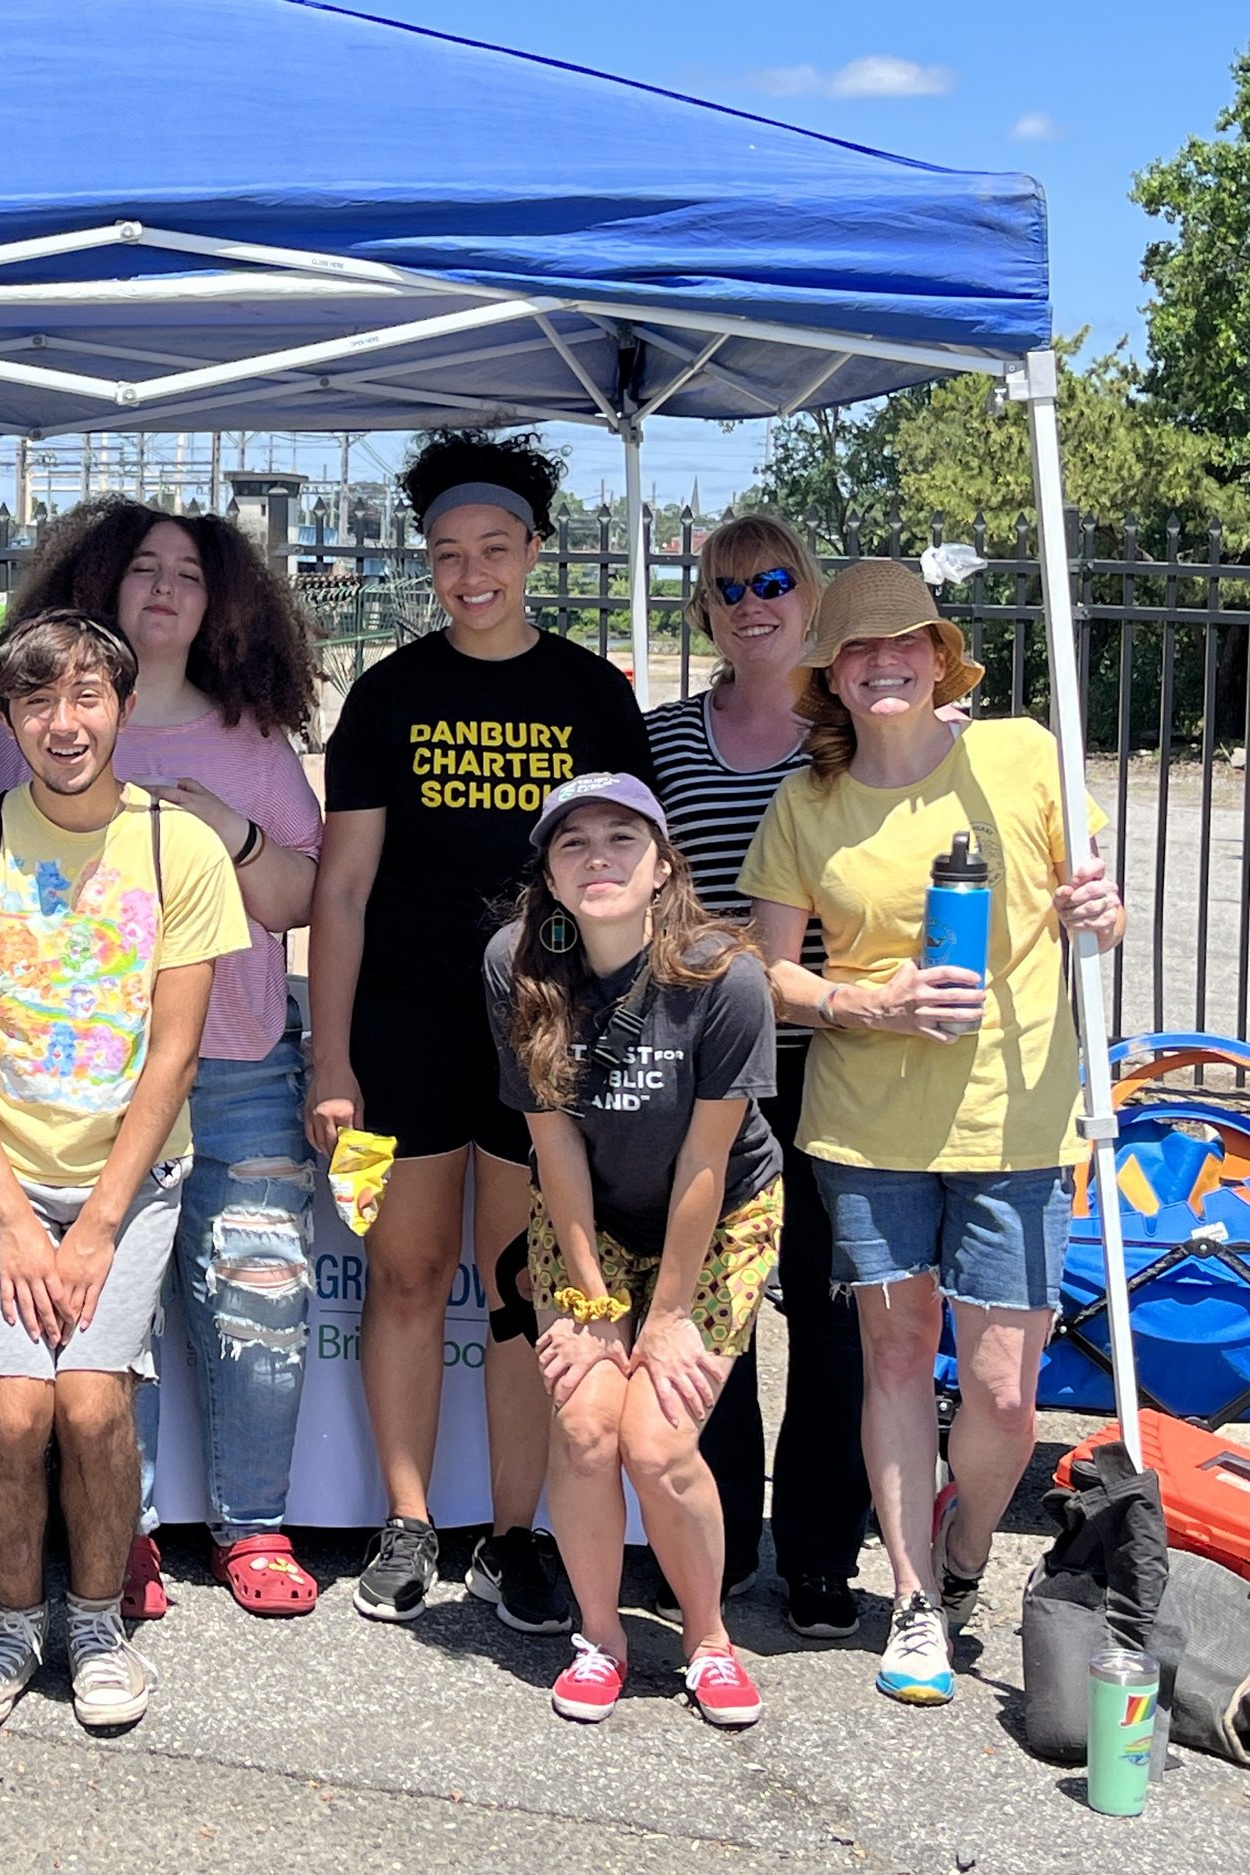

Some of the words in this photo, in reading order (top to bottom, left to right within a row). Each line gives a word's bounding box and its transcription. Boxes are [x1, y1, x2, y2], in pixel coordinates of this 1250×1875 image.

[410, 720, 573, 749] DANBURY
[412, 747, 574, 779] CHARTER
[571, 1044, 653, 1064] TST
[605, 1070, 664, 1089] BLIC
